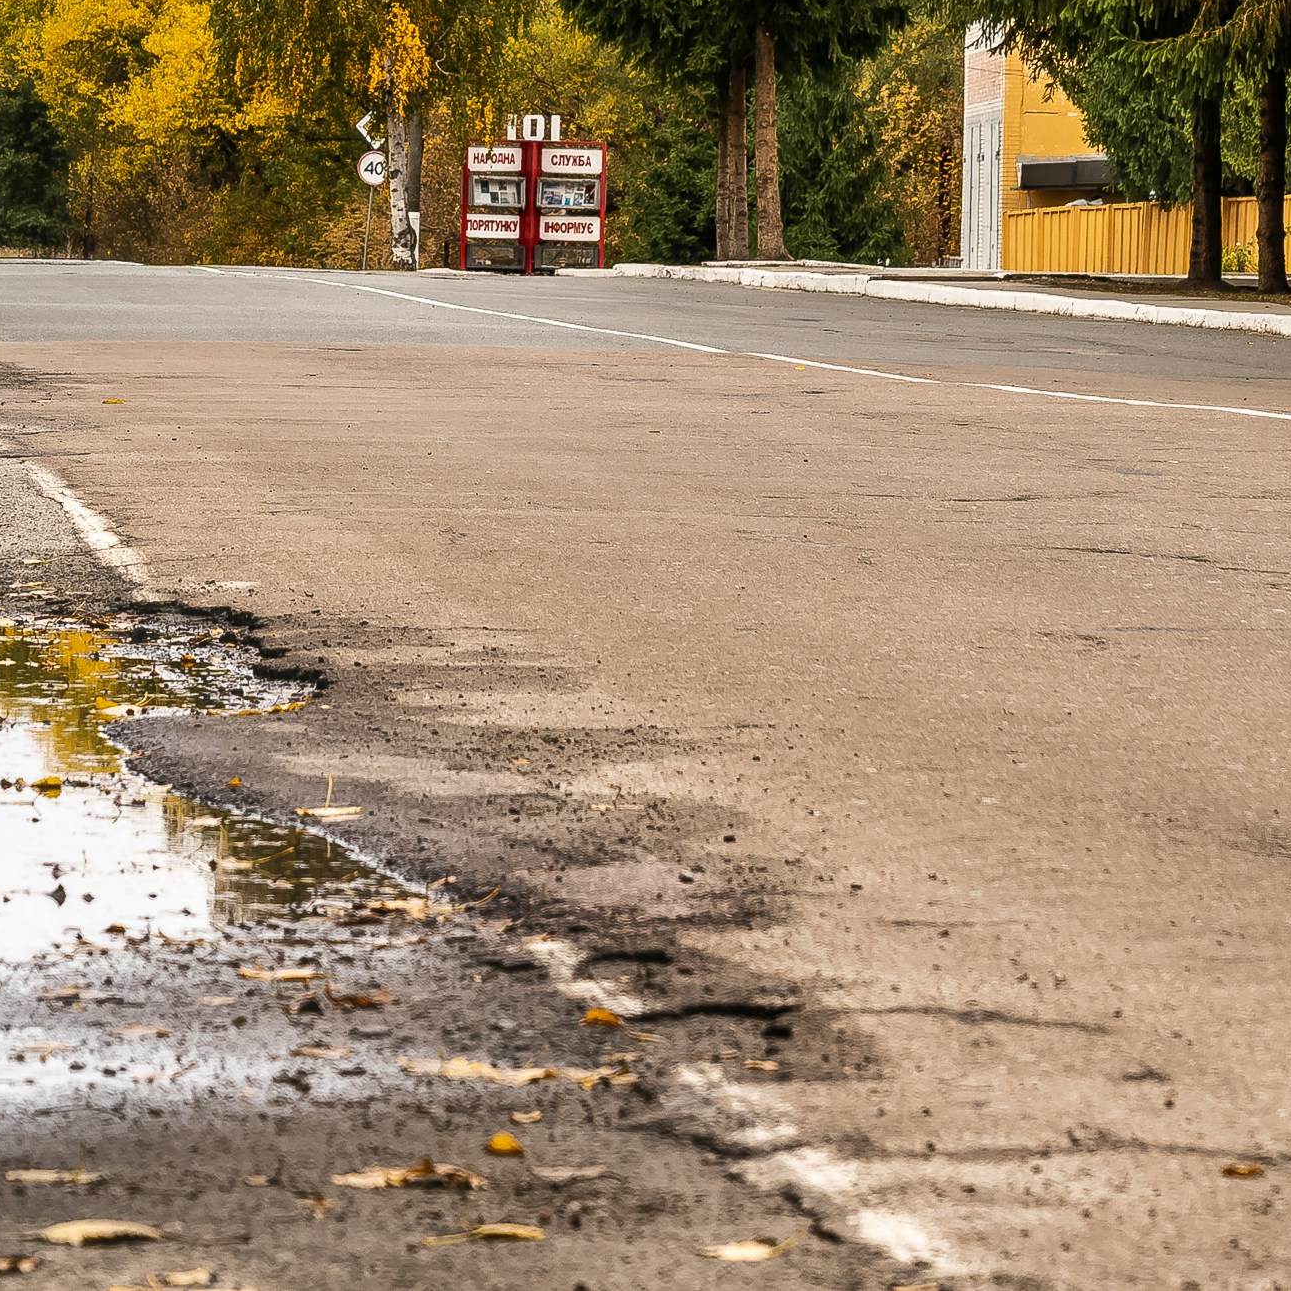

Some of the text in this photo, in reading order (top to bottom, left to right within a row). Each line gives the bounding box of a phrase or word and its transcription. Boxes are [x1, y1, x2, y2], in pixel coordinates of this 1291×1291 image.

[507, 114, 560, 141] 101
[551, 154, 592, 167] СЛУЖБА
[364, 161, 384, 175] 40
[467, 219, 518, 232] ПОРЯТУНКУ
[544, 222, 594, 234] ІНФОРМУЄ
